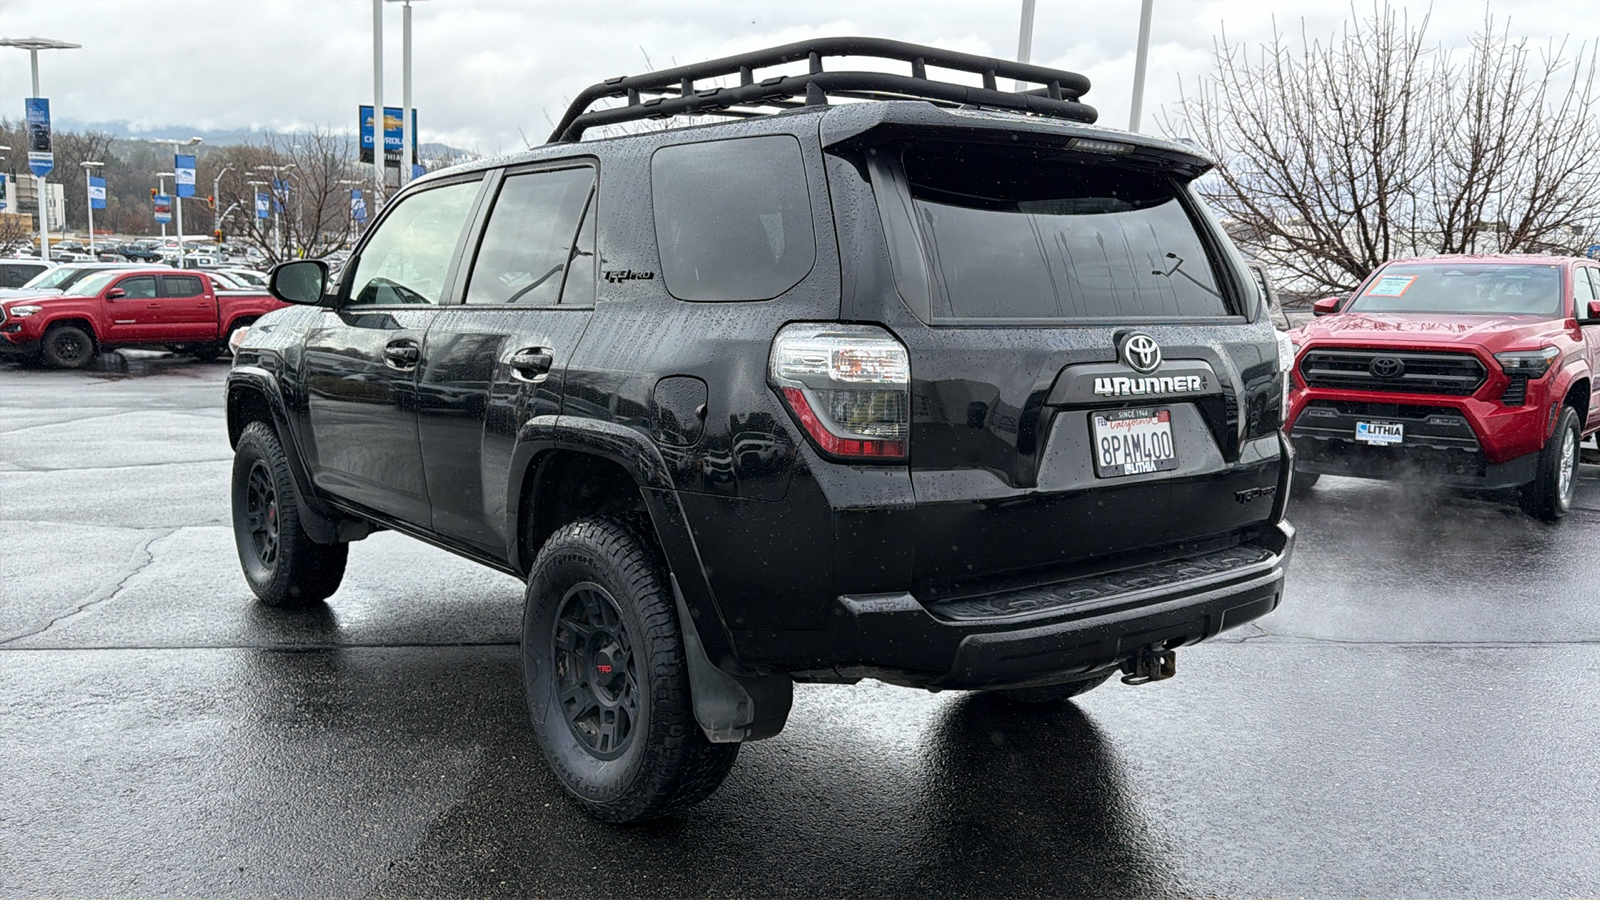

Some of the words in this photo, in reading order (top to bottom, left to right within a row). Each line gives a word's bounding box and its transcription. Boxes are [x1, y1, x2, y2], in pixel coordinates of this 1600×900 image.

[364, 135, 404, 145] CHROL
[602, 269, 631, 283] TRD
[631, 271, 655, 280] PRO
[1093, 375, 1201, 397] 4RUNNER
[1118, 411, 1135, 419] SINCE
[1136, 409, 1148, 417] 1946
[1110, 417, 1158, 432] California
[1367, 424, 1402, 437] LITHIA
[1101, 430, 1172, 466] 8PAM400
[1131, 460, 1157, 474] LITHIA
[596, 664, 612, 674] TRD
